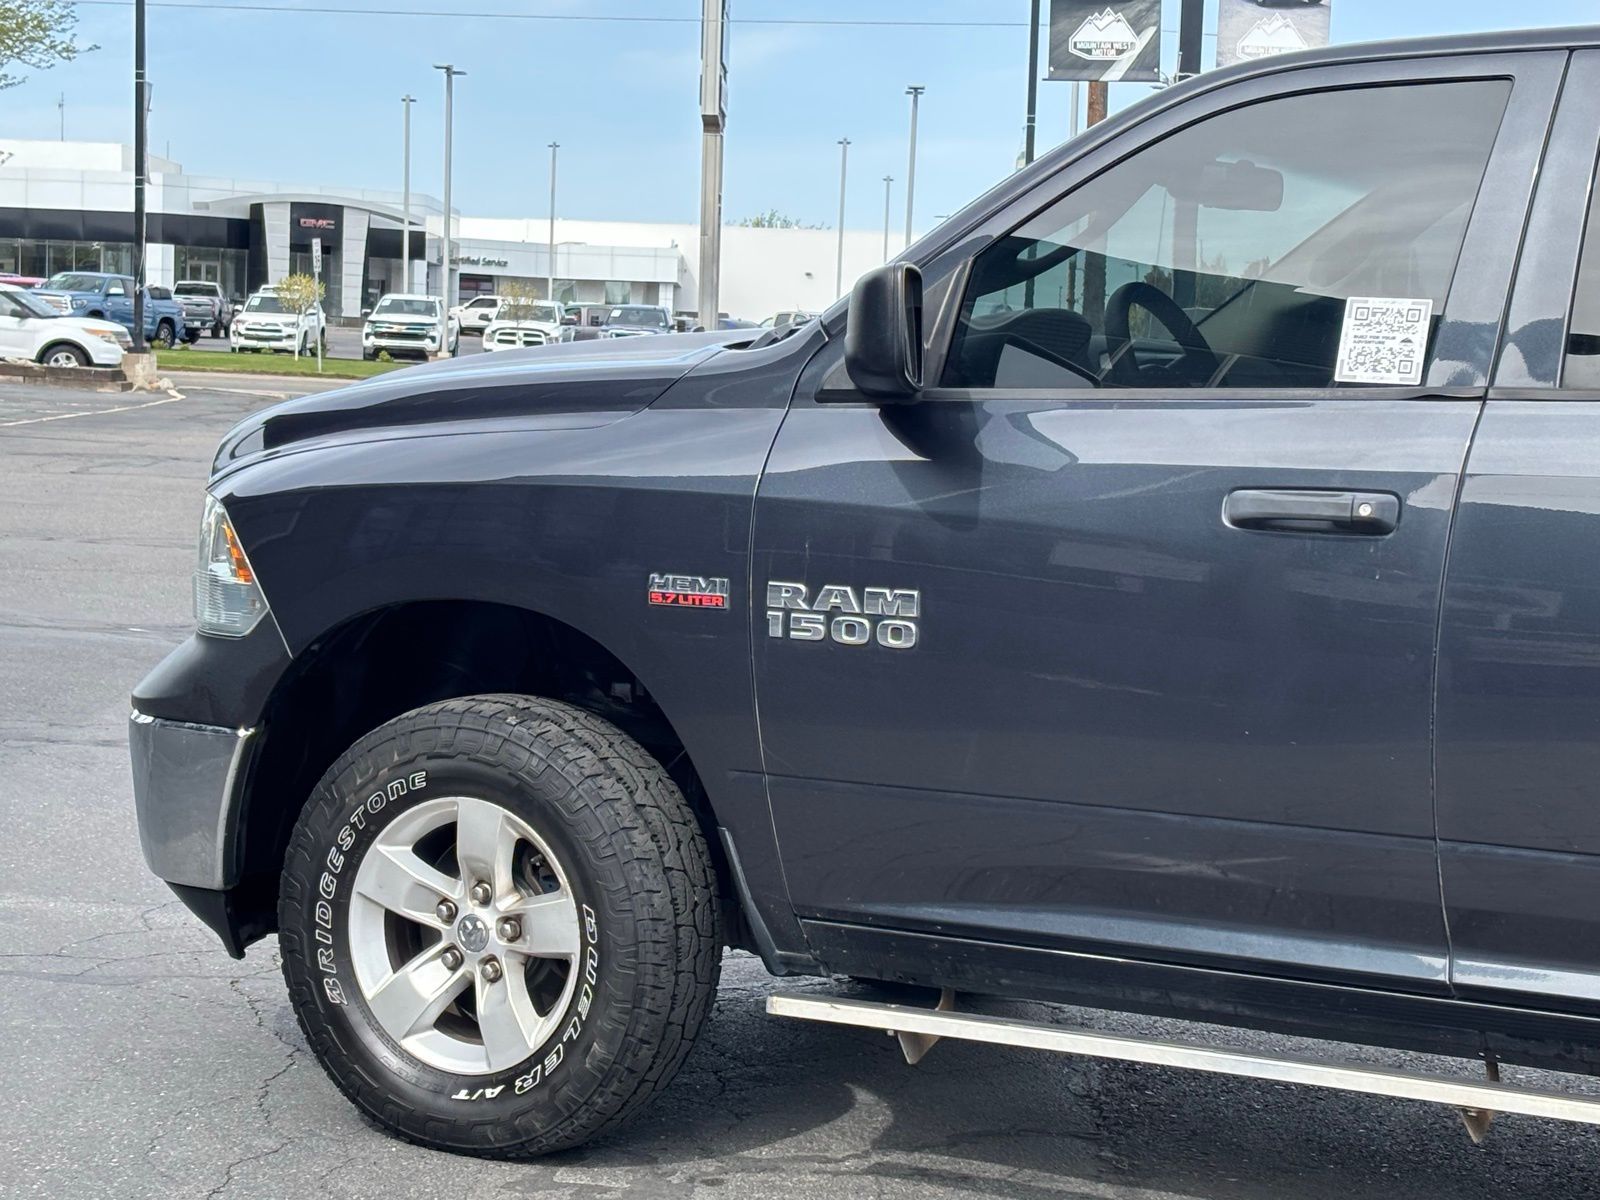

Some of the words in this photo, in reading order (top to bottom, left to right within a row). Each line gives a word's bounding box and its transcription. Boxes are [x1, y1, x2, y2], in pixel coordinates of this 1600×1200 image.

[1076, 41, 1111, 49] MOUNTAIN
[1112, 42, 1132, 50] WEST
[300, 218, 335, 229] GMC
[481, 257, 508, 268] Service
[649, 573, 729, 595] HEMI
[651, 591, 676, 604] 5.7
[678, 593, 724, 607] LITER
[766, 580, 921, 617] RAM
[766, 610, 917, 649] 1500
[315, 771, 427, 1006] BRIDGESTONE
[514, 903, 598, 1095] DUELER
[450, 1084, 506, 1101] A/T
